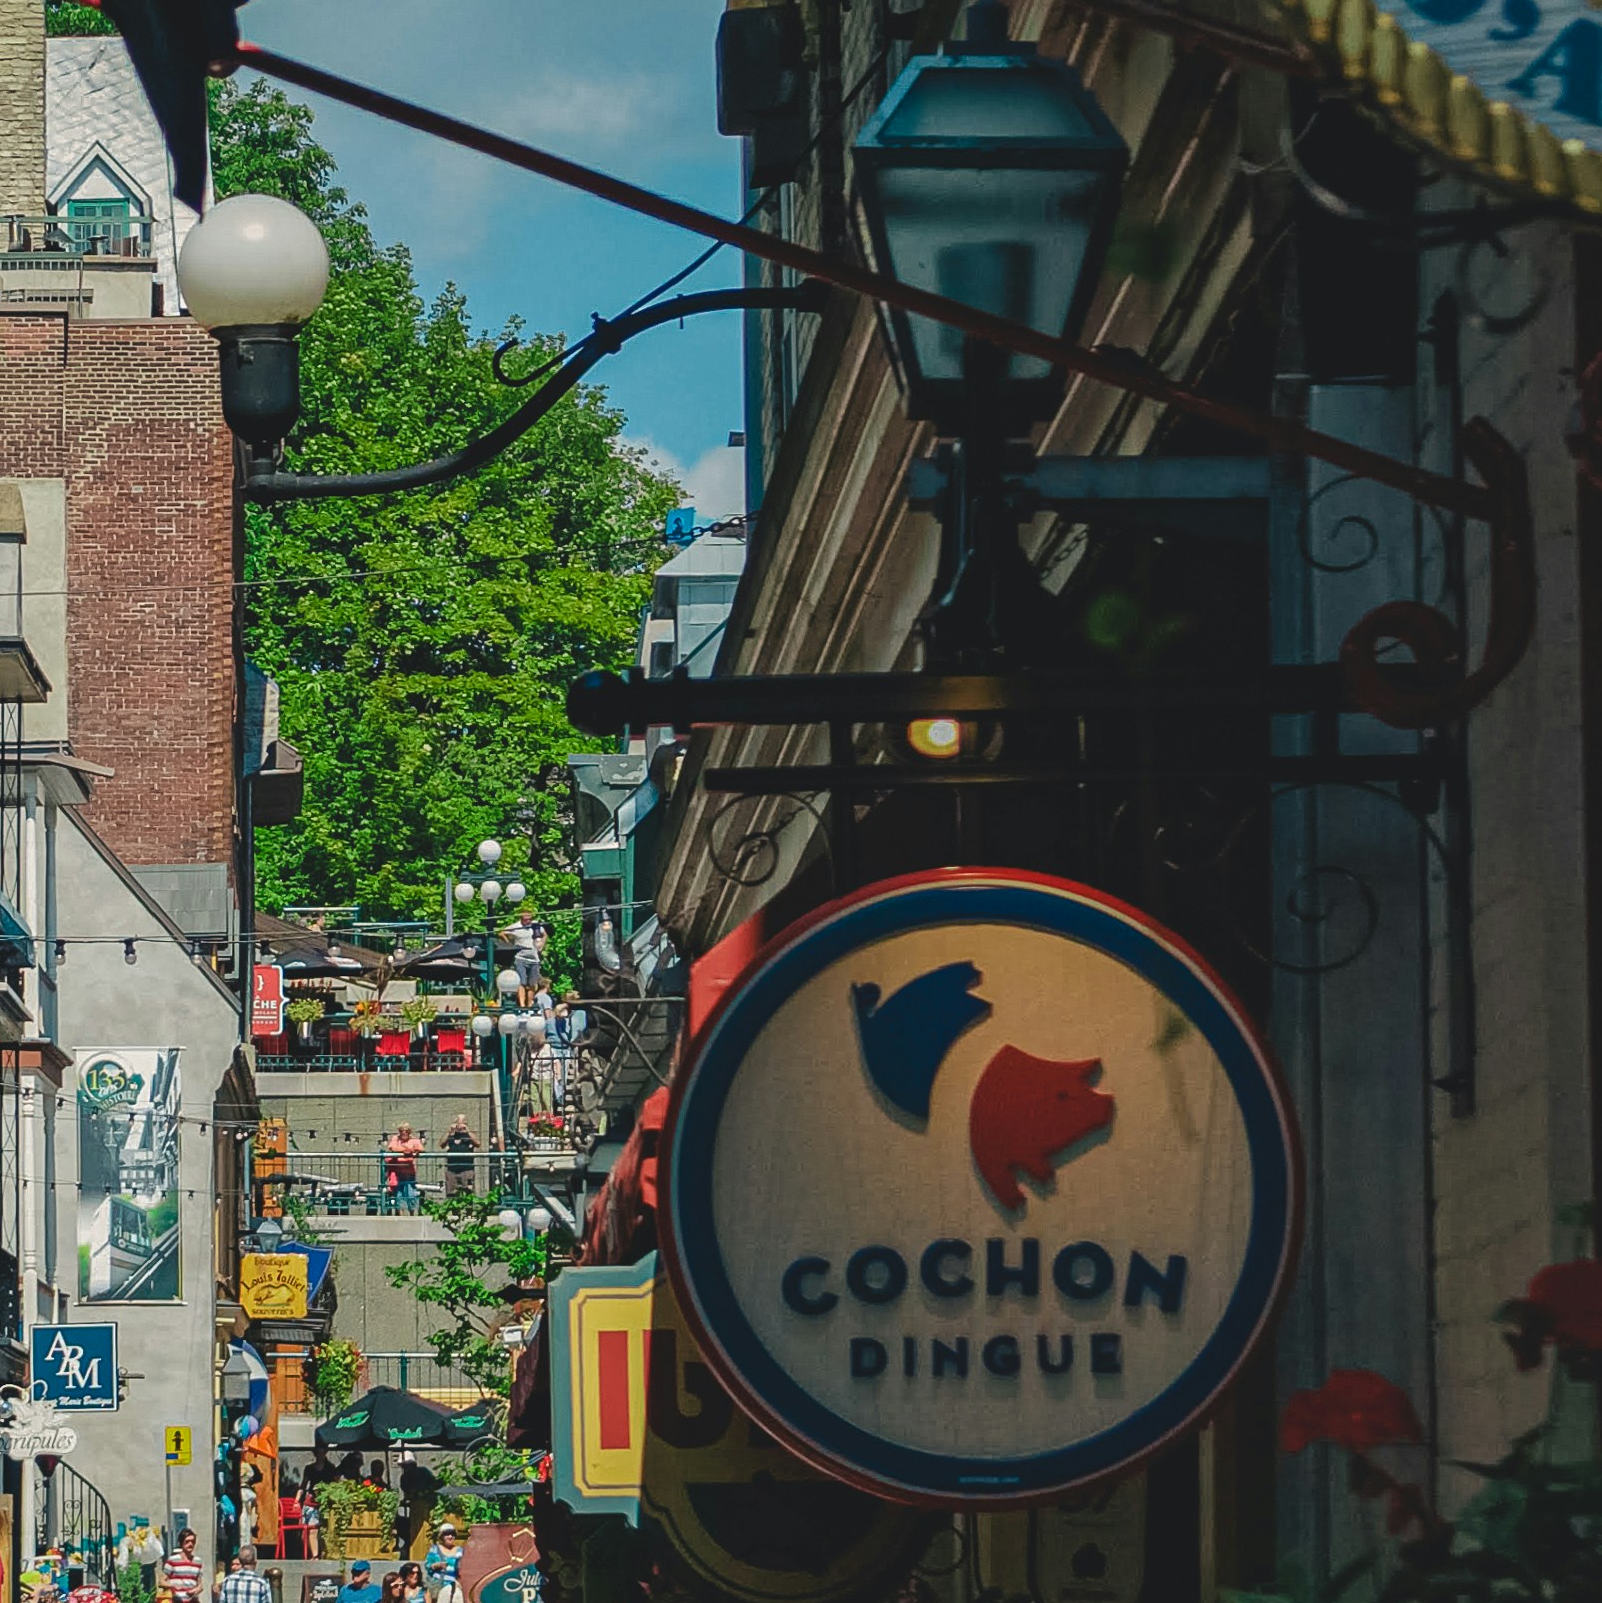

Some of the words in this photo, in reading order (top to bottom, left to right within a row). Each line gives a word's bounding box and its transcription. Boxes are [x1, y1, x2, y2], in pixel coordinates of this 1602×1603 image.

[89, 1067, 125, 1090] 135
[240, 1273, 273, 1292] Louis
[781, 1237, 1188, 1315] COCHON
[850, 1333, 1123, 1378] DINGUE
